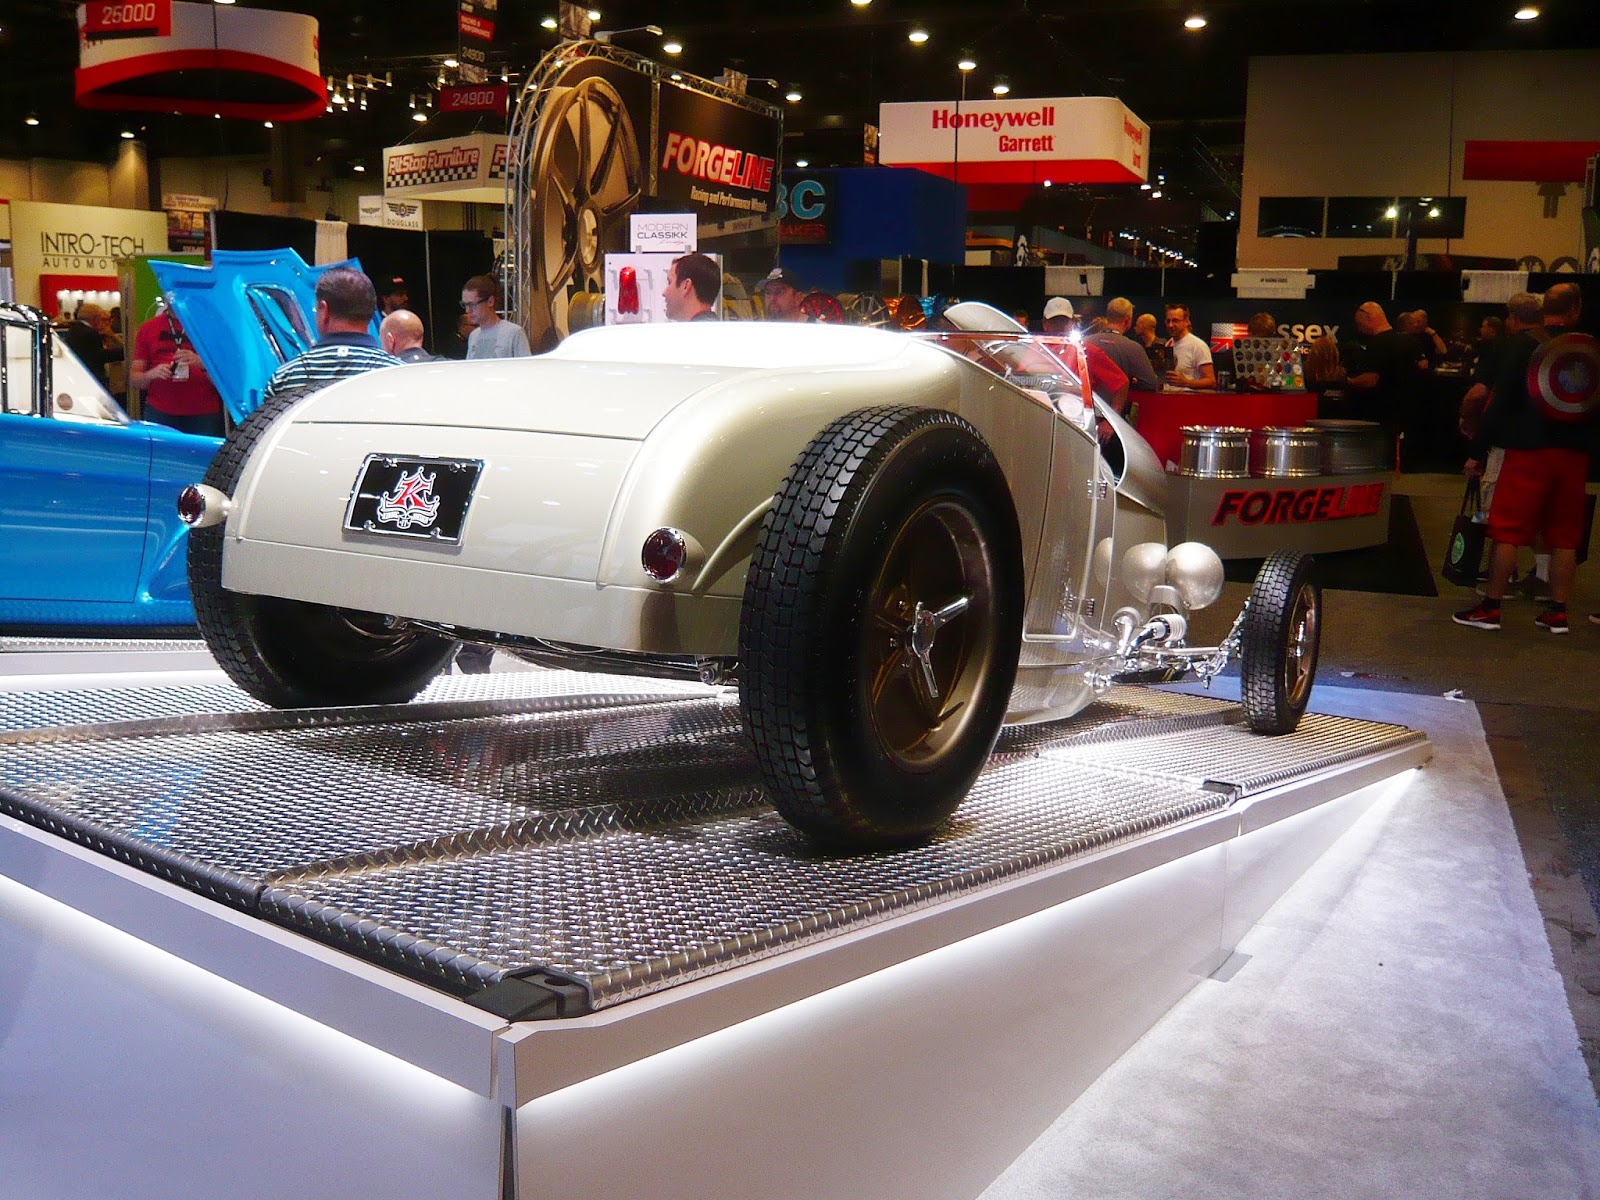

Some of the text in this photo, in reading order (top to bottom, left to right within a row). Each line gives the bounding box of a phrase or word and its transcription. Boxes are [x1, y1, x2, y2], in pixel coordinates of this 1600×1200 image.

[102, 3, 156, 25] 25000
[452, 91, 495, 107] 24900
[932, 106, 1055, 132] Honeywell
[999, 135, 1054, 152] Garrett
[427, 146, 480, 172] Furniture
[661, 131, 775, 193] FORGELINE
[386, 218, 419, 228] DOUGLASS
[637, 223, 689, 231] MODERN
[41, 231, 145, 257] INTRO-TECH
[637, 231, 688, 239] CLASSIKK
[43, 257, 118, 270] AUTOMOT
[1277, 323, 1340, 343] ssex
